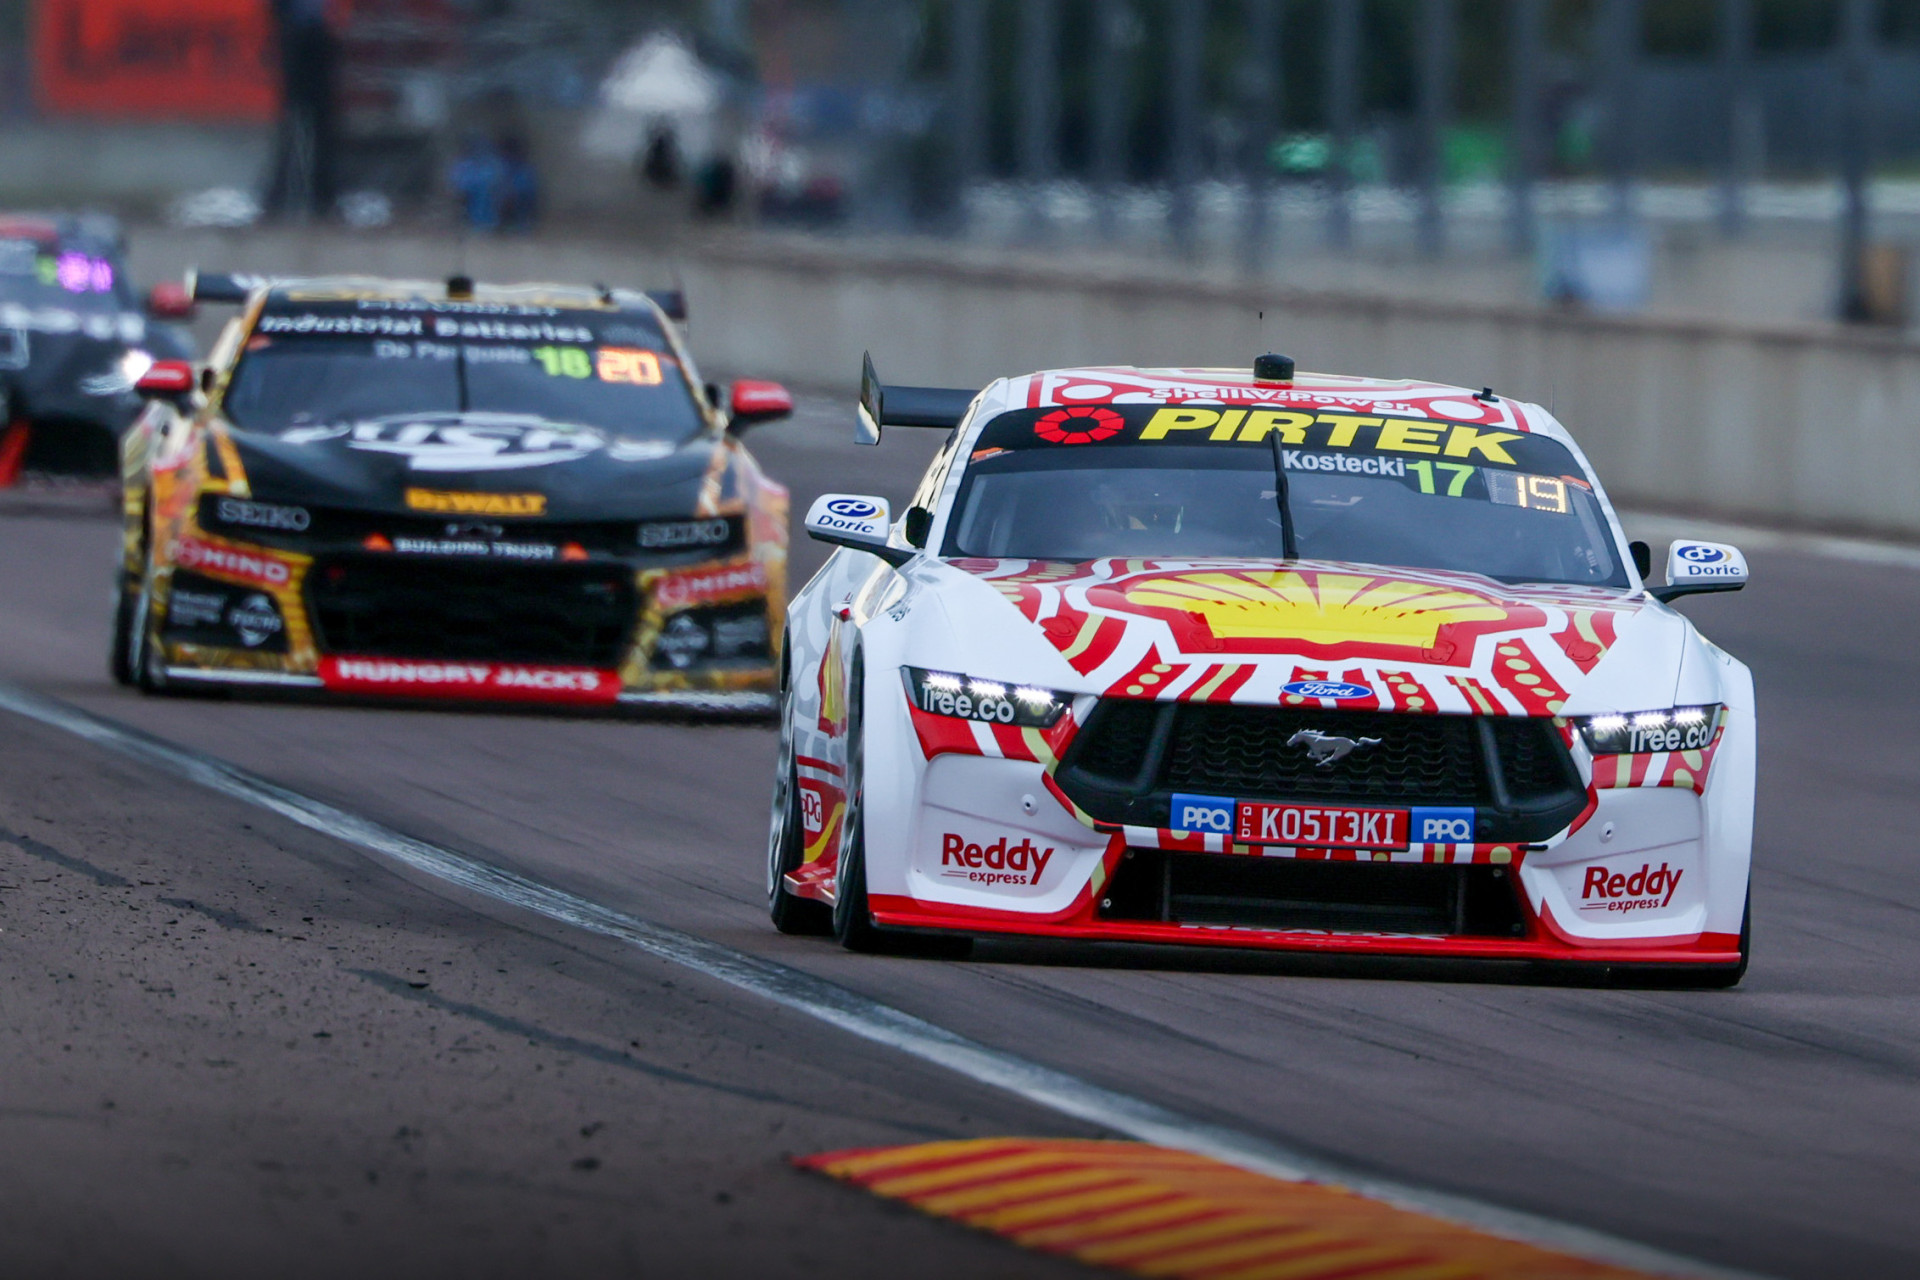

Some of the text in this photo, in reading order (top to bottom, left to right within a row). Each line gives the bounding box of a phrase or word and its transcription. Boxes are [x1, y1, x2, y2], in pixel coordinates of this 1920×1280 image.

[597, 345, 662, 385] 20
[1139, 408, 1524, 466] PIRTEK
[1282, 450, 1475, 497] Kostecki 17
[1517, 476, 1566, 513] 19
[219, 498, 311, 531] SEIKO
[817, 515, 874, 533] Doric
[638, 519, 729, 547] SEIKO
[394, 537, 557, 560] BUILDING TRUST
[204, 549, 289, 582] HINO
[1688, 565, 1740, 576] Doric
[337, 660, 490, 684] HUNGRY
[922, 682, 1015, 723] Tree.co
[1299, 682, 1355, 697] Ford
[1627, 725, 1710, 752] Tree.co
[1183, 806, 1231, 831] PPQ
[1423, 818, 1471, 840] PPQ
[942, 833, 1055, 885] Reddy
[969, 871, 1027, 886] express
[1582, 862, 1683, 907] Reddy
[1608, 899, 1659, 913] express
